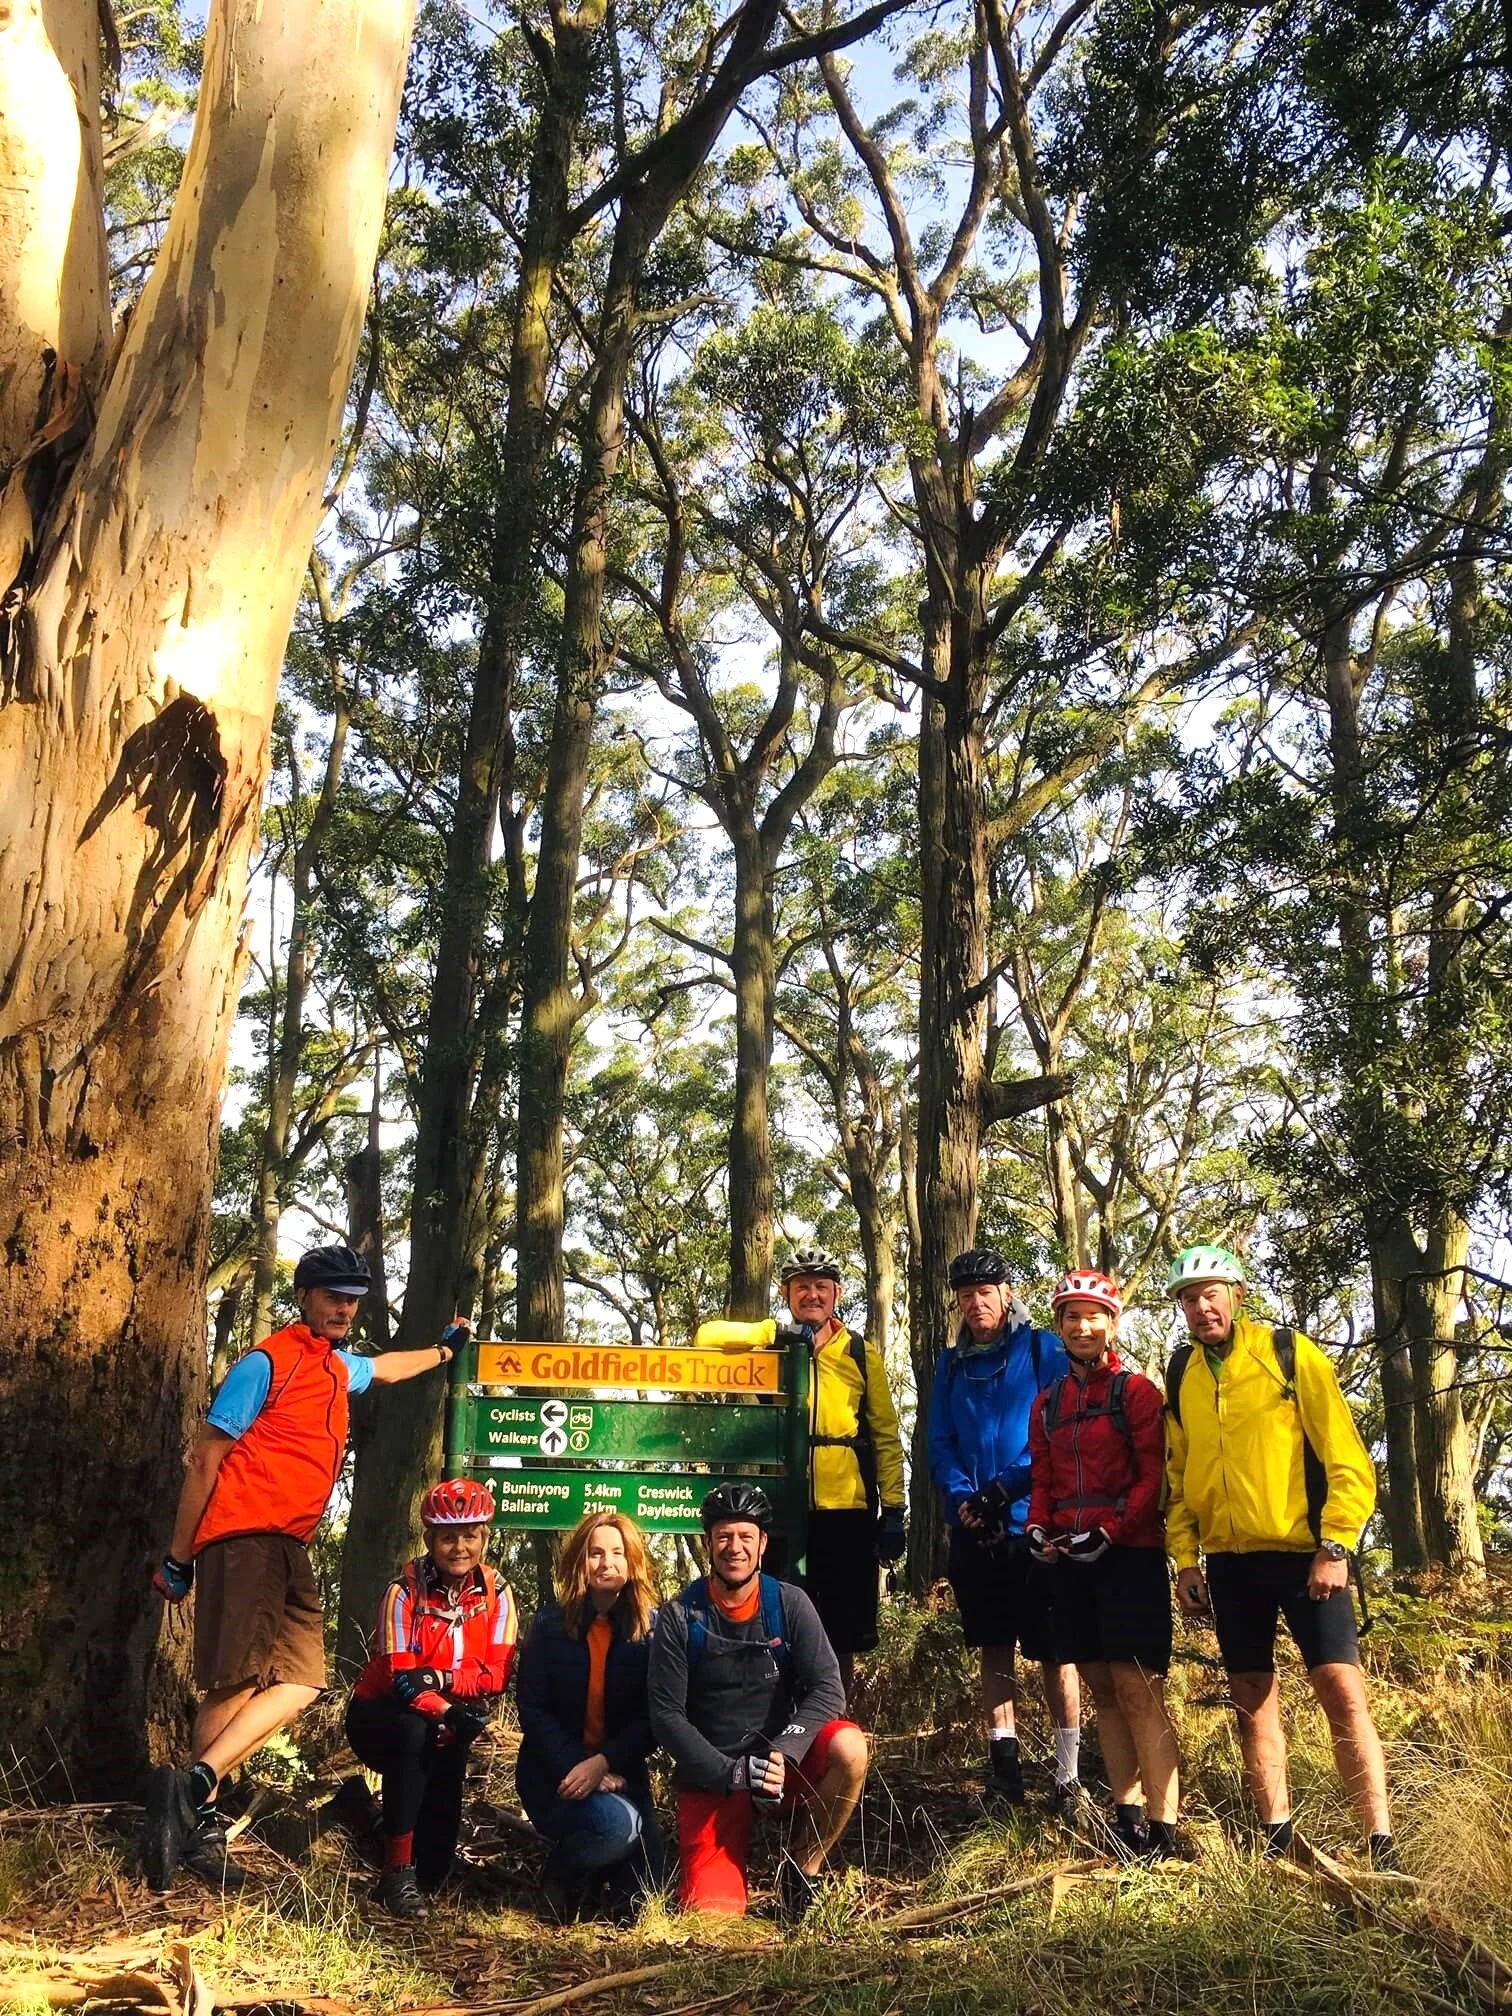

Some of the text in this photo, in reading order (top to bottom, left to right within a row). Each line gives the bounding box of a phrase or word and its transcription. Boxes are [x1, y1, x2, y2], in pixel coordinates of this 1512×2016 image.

[531, 1352, 765, 1386] Goldfields Track
[490, 1408, 536, 1423] Cyclists
[488, 1431, 539, 1445] Walkers
[502, 1481, 693, 1500] Buninyong 5.4km Creswick
[501, 1499, 550, 1513] Ballarat
